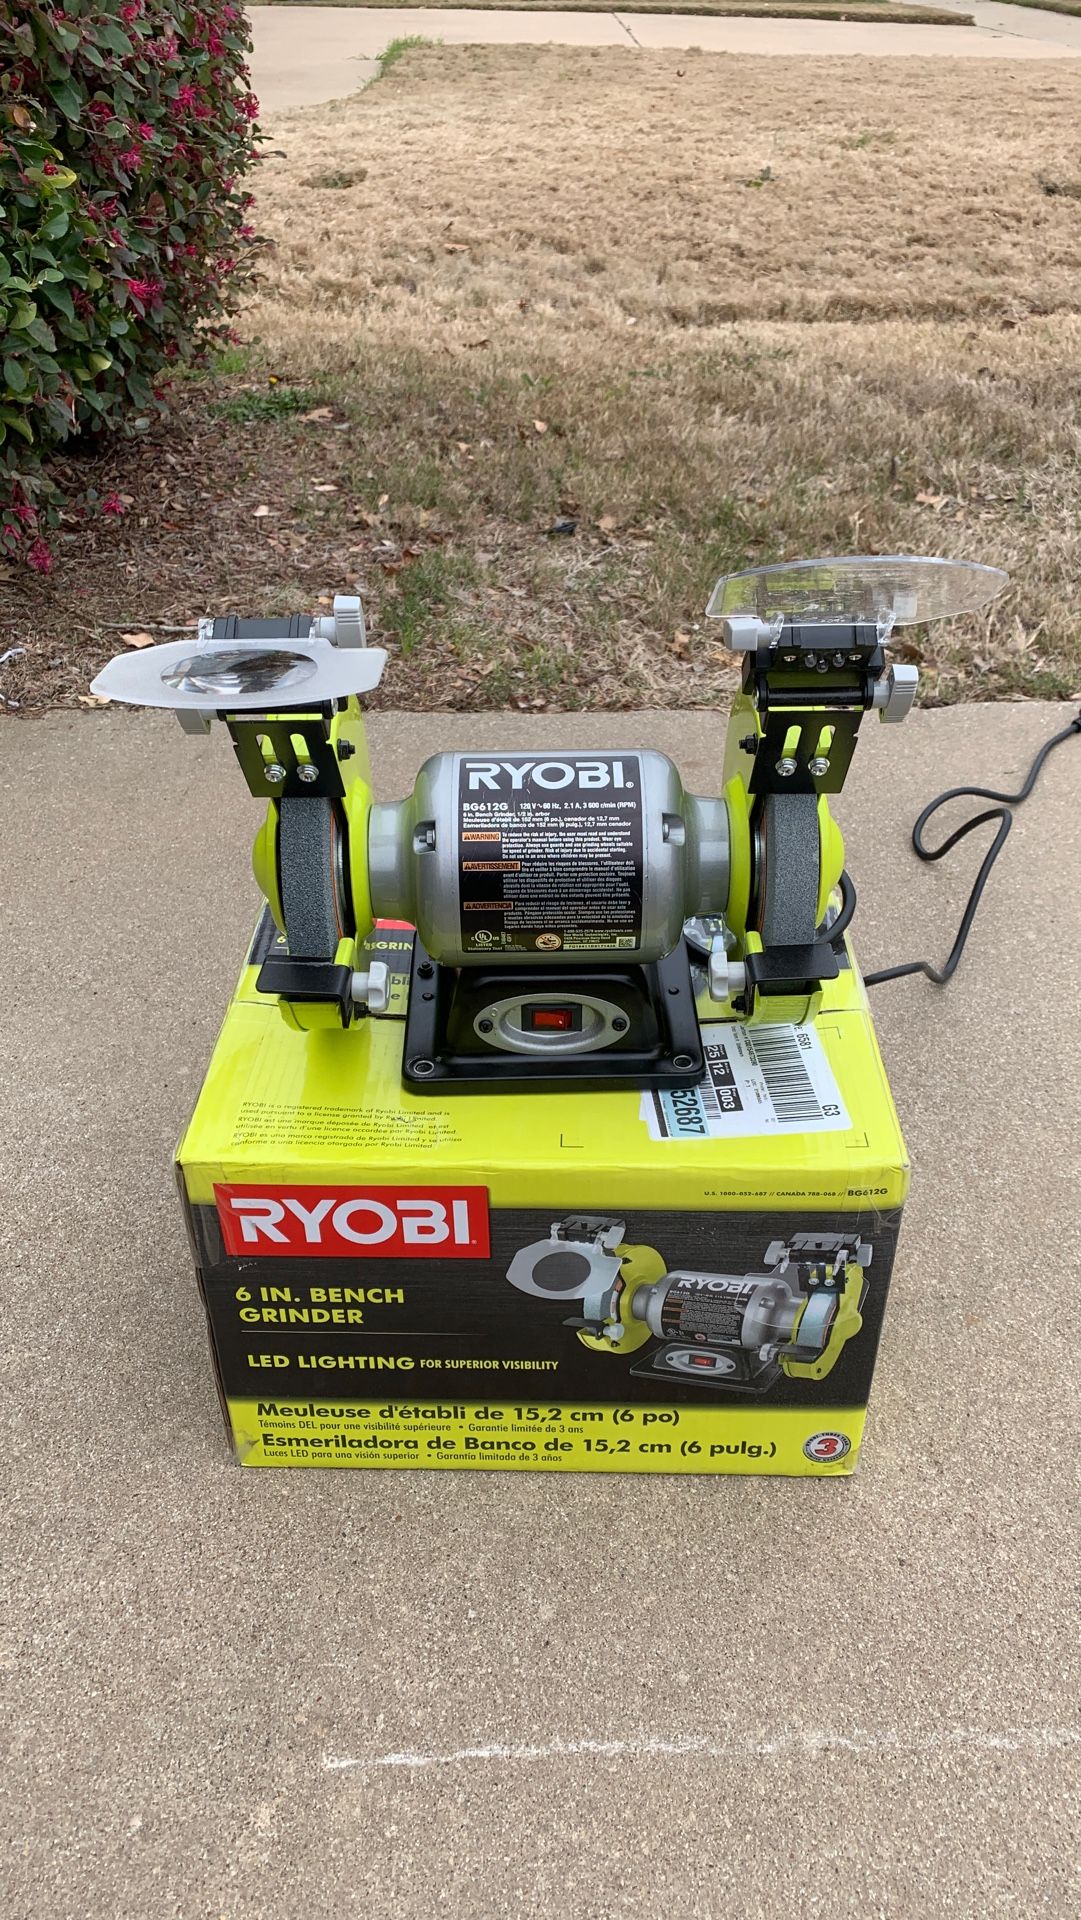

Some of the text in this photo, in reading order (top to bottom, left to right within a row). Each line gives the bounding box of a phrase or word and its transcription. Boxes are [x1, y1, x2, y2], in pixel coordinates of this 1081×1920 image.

[463, 803, 508, 811] BG612G
[470, 862, 519, 870] AVERTISSEMENT
[796, 1033, 812, 1050] 6581
[707, 1045, 720, 1058] 25
[712, 1063, 726, 1075] 12
[720, 1089, 735, 1109] 003
[822, 1104, 841, 1117] G3
[847, 1188, 888, 1197] BG612G
[234, 1286, 405, 1304] 6 IN. BENCH
[239, 1308, 364, 1325] GRINDER
[248, 1354, 559, 1371] LED LIGHTING FOR SUPERIOR VISIBILITY
[257, 1403, 680, 1426] Meuleuse d'établi de 15,2 cm (6 po)
[259, 1420, 296, 1429] Témoins
[298, 1420, 317, 1430] DEL
[320, 1422, 341, 1432] pour
[363, 1420, 401, 1431] visibilité
[403, 1422, 451, 1433] supérieure
[468, 1423, 509, 1433] Garantie
[511, 1423, 543, 1433] limitée
[545, 1424, 556, 1433] de
[559, 1425, 565, 1433] 3
[568, 1426, 584, 1434] ans
[262, 1434, 777, 1458] Esmeriladora de Banco de 15,2 cm (6 pulg.)
[815, 1438, 839, 1455] 3
[264, 1449, 288, 1458] Luces
[290, 1449, 308, 1458] LED
[311, 1452, 333, 1460] para
[354, 1450, 380, 1459] visión
[383, 1451, 420, 1461] superior
[437, 1451, 477, 1461] Garantía
[479, 1452, 516, 1461] limitada
[518, 1452, 530, 1461] de
[532, 1453, 538, 1461] 3
[541, 1454, 562, 1462] años
